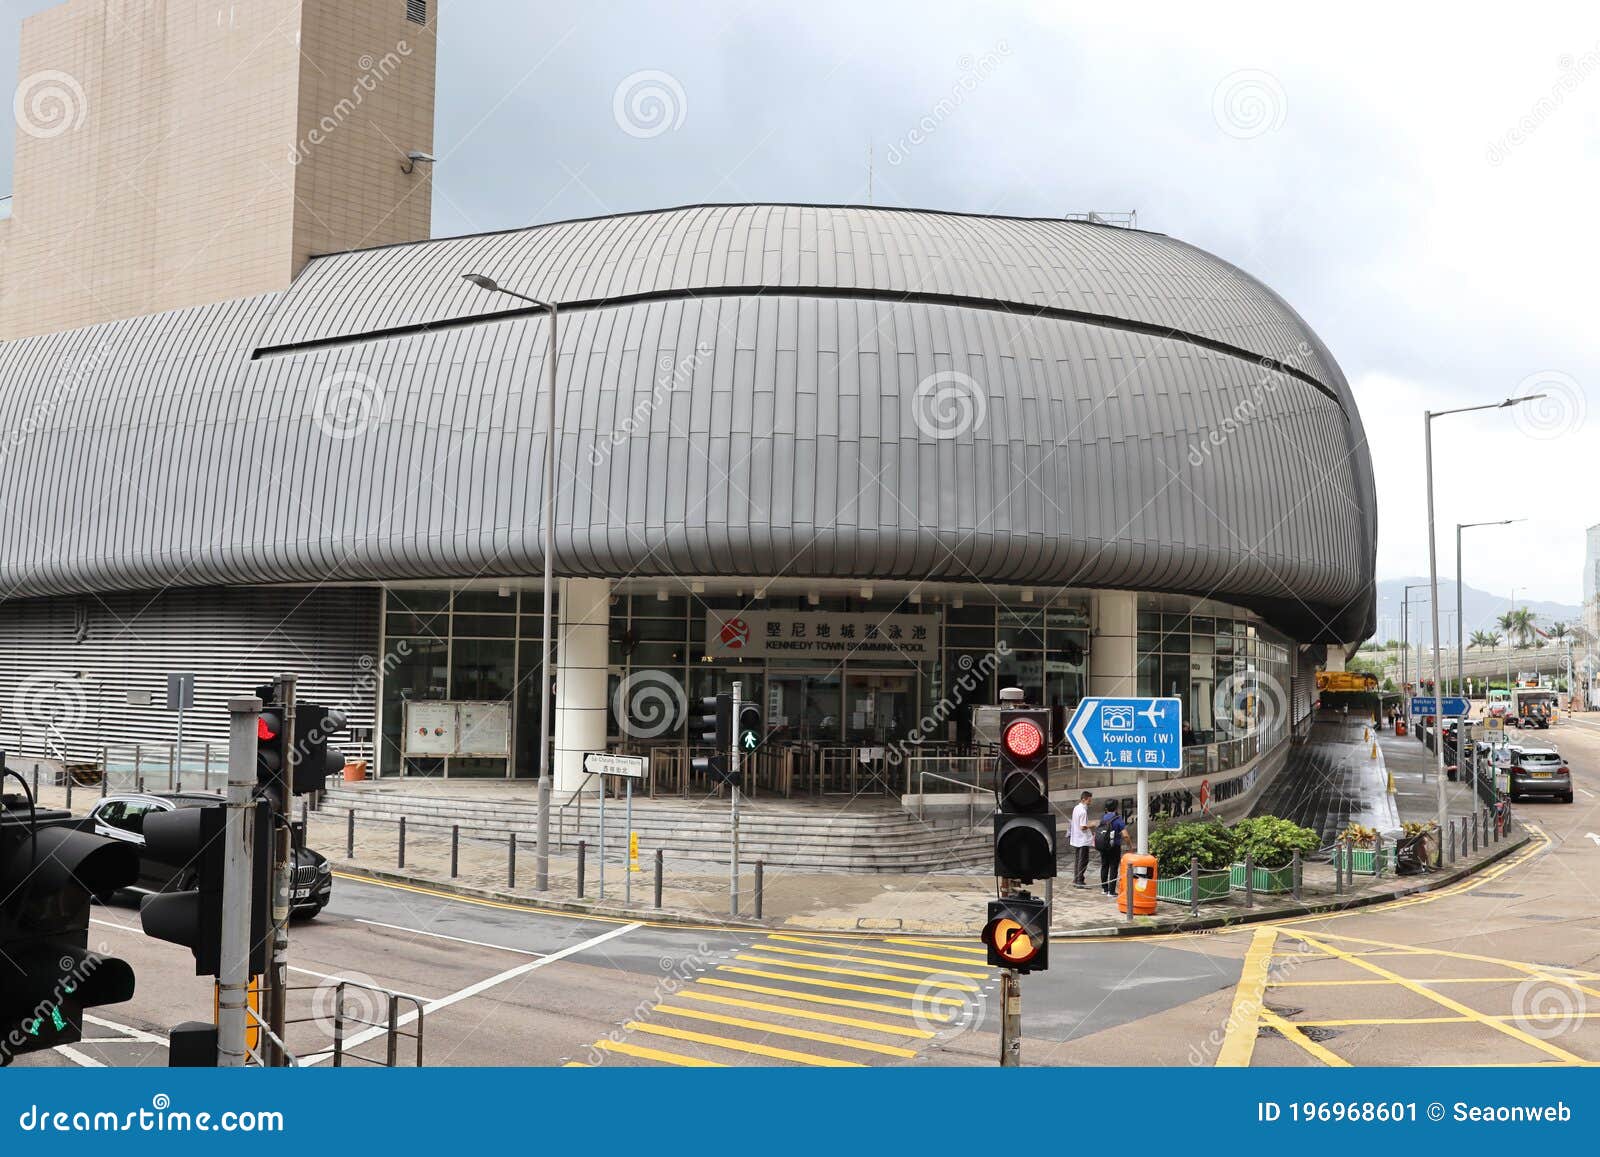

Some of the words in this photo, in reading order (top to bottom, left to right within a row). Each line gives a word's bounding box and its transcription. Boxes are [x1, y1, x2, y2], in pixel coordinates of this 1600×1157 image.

[766, 641, 812, 650] KENNEDY
[816, 642, 844, 651] TOWN
[847, 642, 897, 652] SWIMMING
[900, 643, 926, 652] POOL
[1103, 733, 1147, 743] Kowloon
[1154, 733, 1173, 744] (W)
